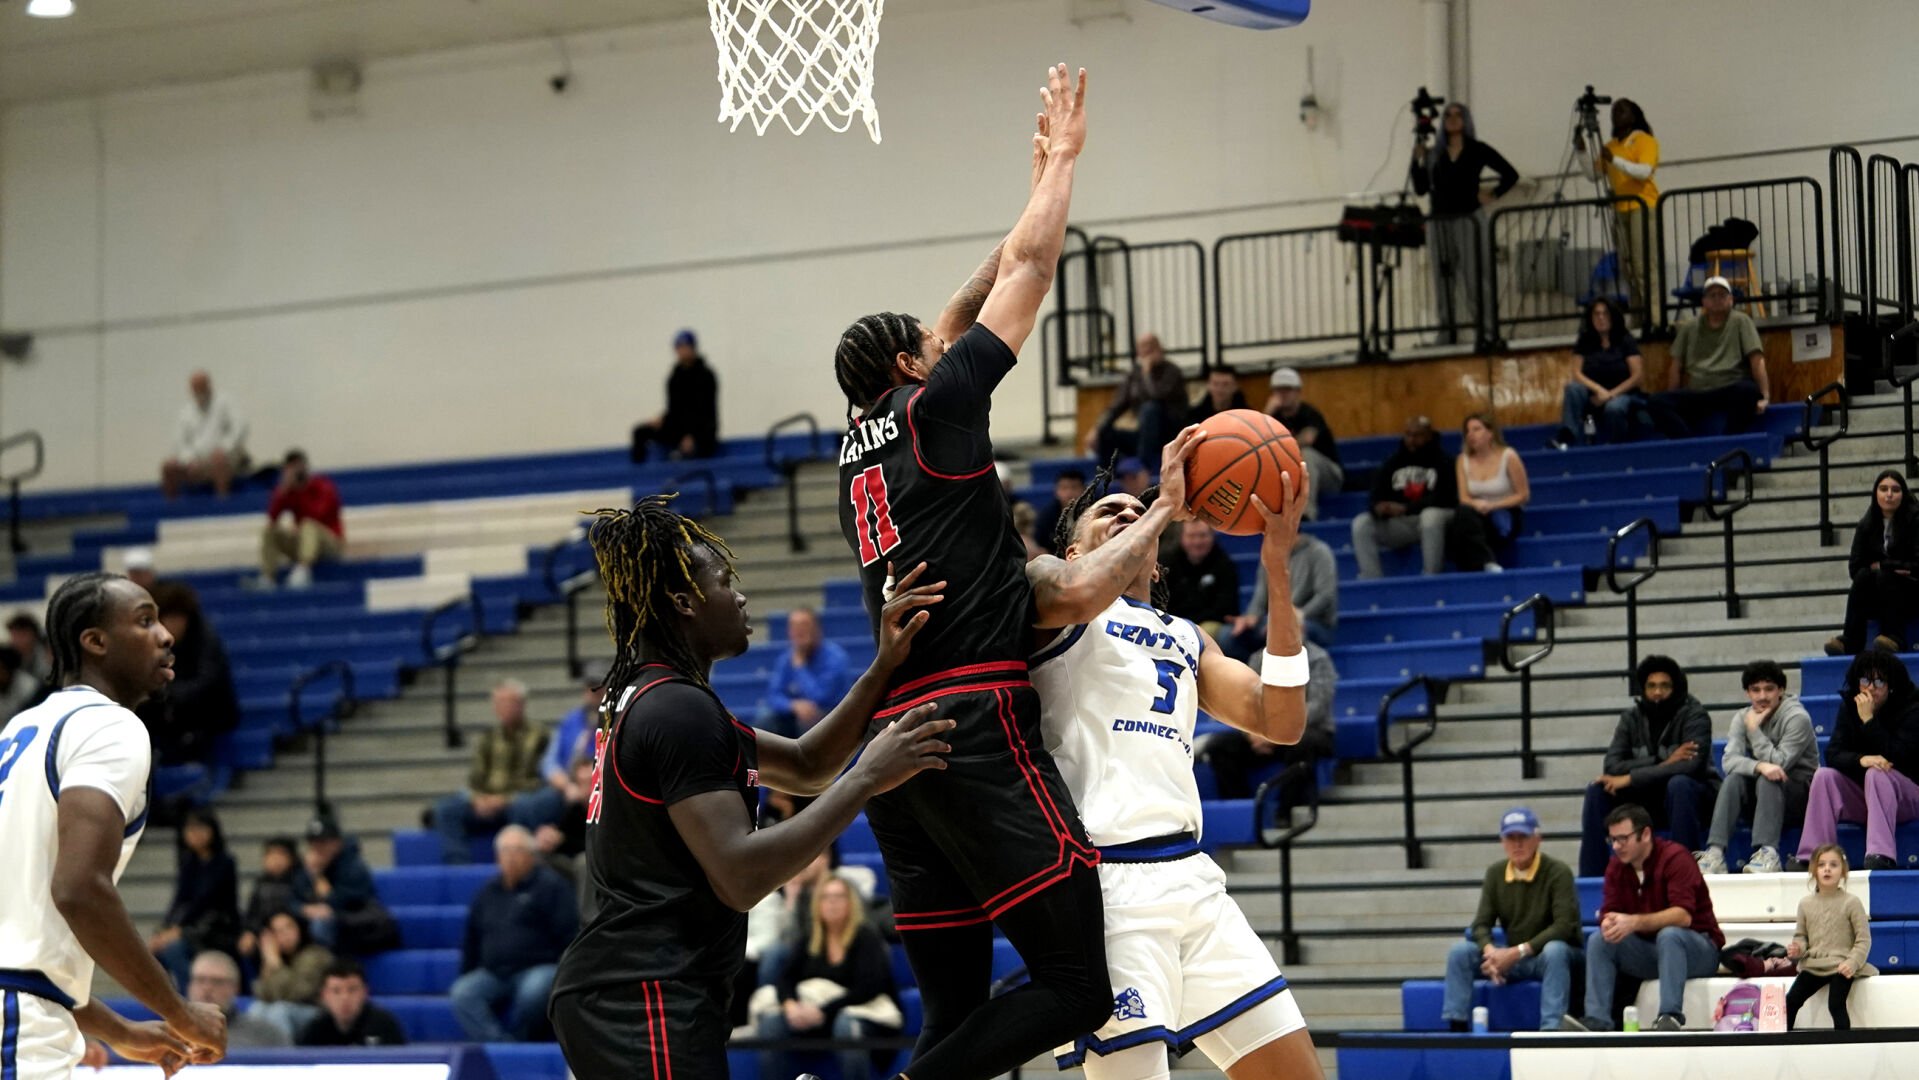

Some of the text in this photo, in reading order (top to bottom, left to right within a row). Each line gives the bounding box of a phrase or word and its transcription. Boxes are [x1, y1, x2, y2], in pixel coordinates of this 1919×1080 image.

[851, 463, 901, 568] 11
[1208, 479, 1243, 515] THE
[1150, 658, 1186, 715] 5
